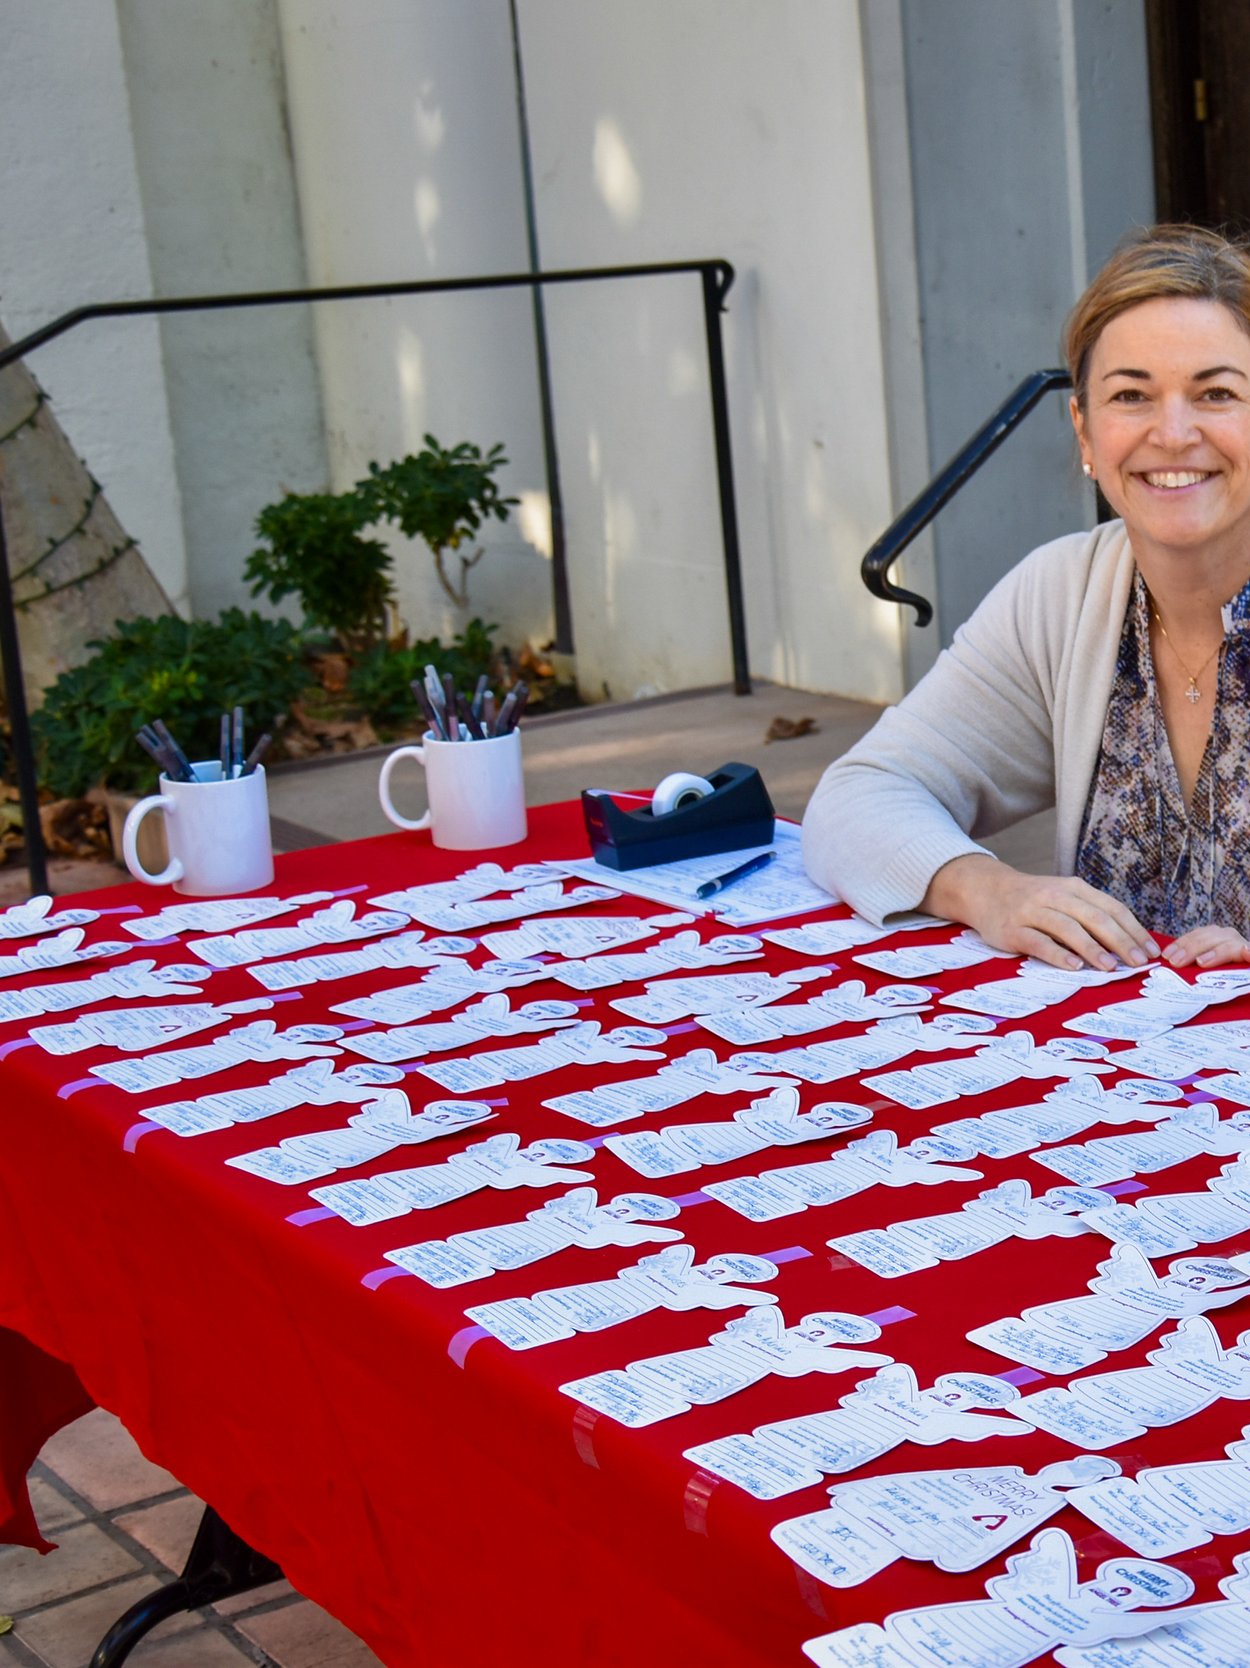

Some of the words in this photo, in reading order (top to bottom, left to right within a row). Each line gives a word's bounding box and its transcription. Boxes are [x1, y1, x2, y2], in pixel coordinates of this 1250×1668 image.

[947, 1379, 1000, 1404] CHRISTMAS!
[969, 1380, 1000, 1395] MERRY
[953, 1473, 1032, 1518] CHRISTMAS!
[988, 1475, 1038, 1502] MERRY
[1115, 1568, 1170, 1598] CHRISTMAS!
[1137, 1570, 1172, 1585] MERRY
